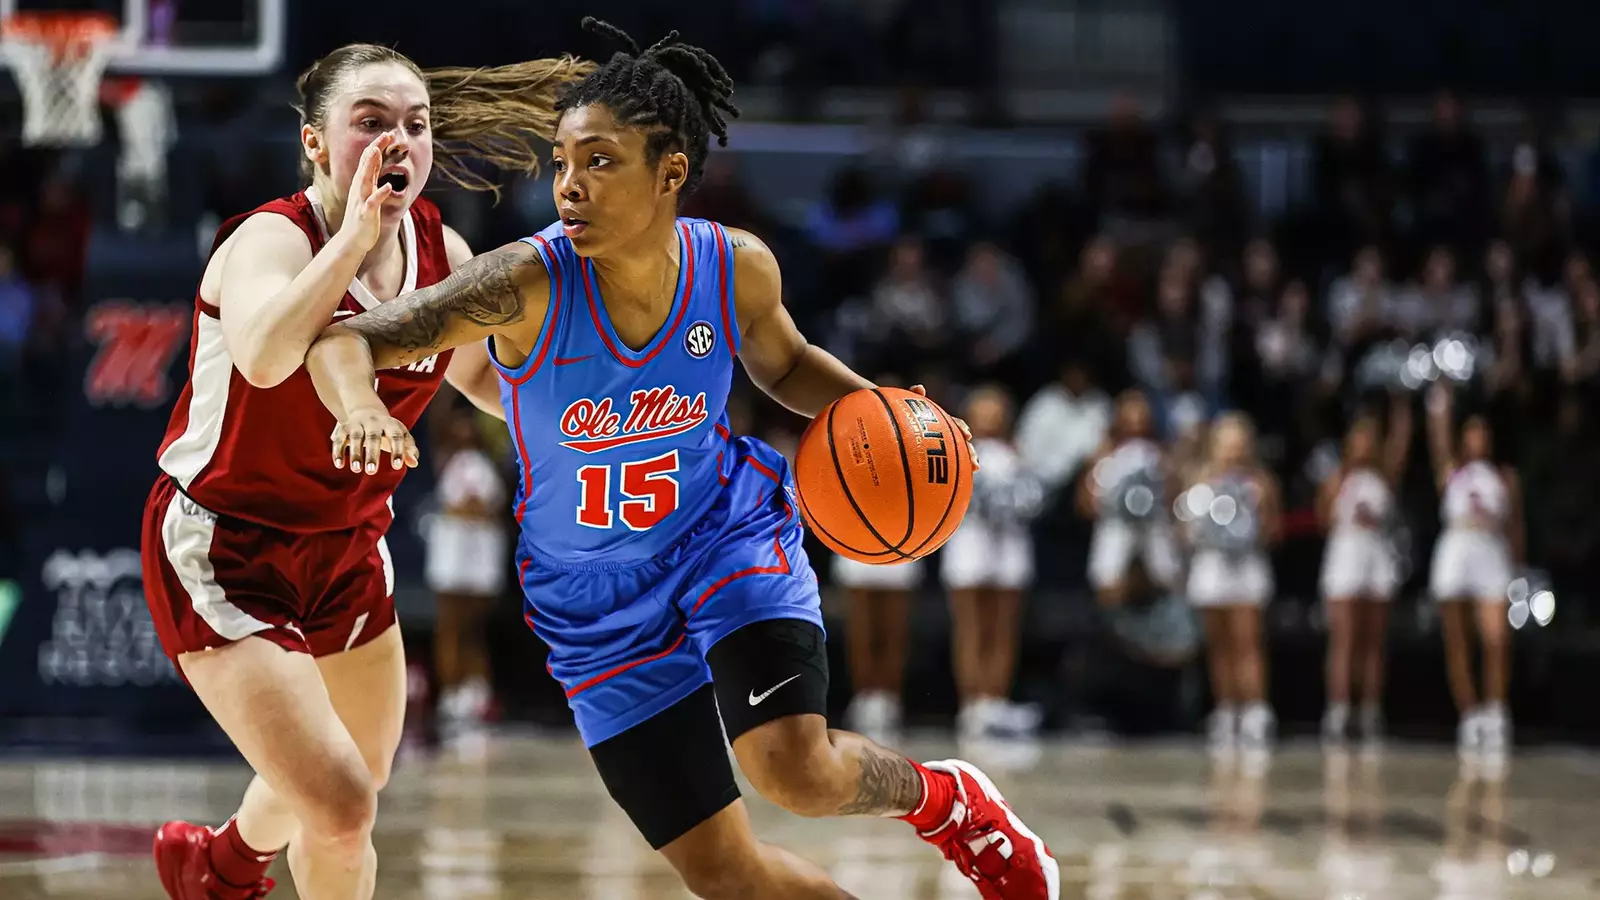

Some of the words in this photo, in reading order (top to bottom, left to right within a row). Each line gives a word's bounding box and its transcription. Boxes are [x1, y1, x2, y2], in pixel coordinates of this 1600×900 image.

[688, 325, 712, 354] SEC
[560, 398, 621, 439] Ole
[622, 385, 708, 433] Miss
[904, 399, 948, 484] ELITE
[576, 449, 680, 531] 15
